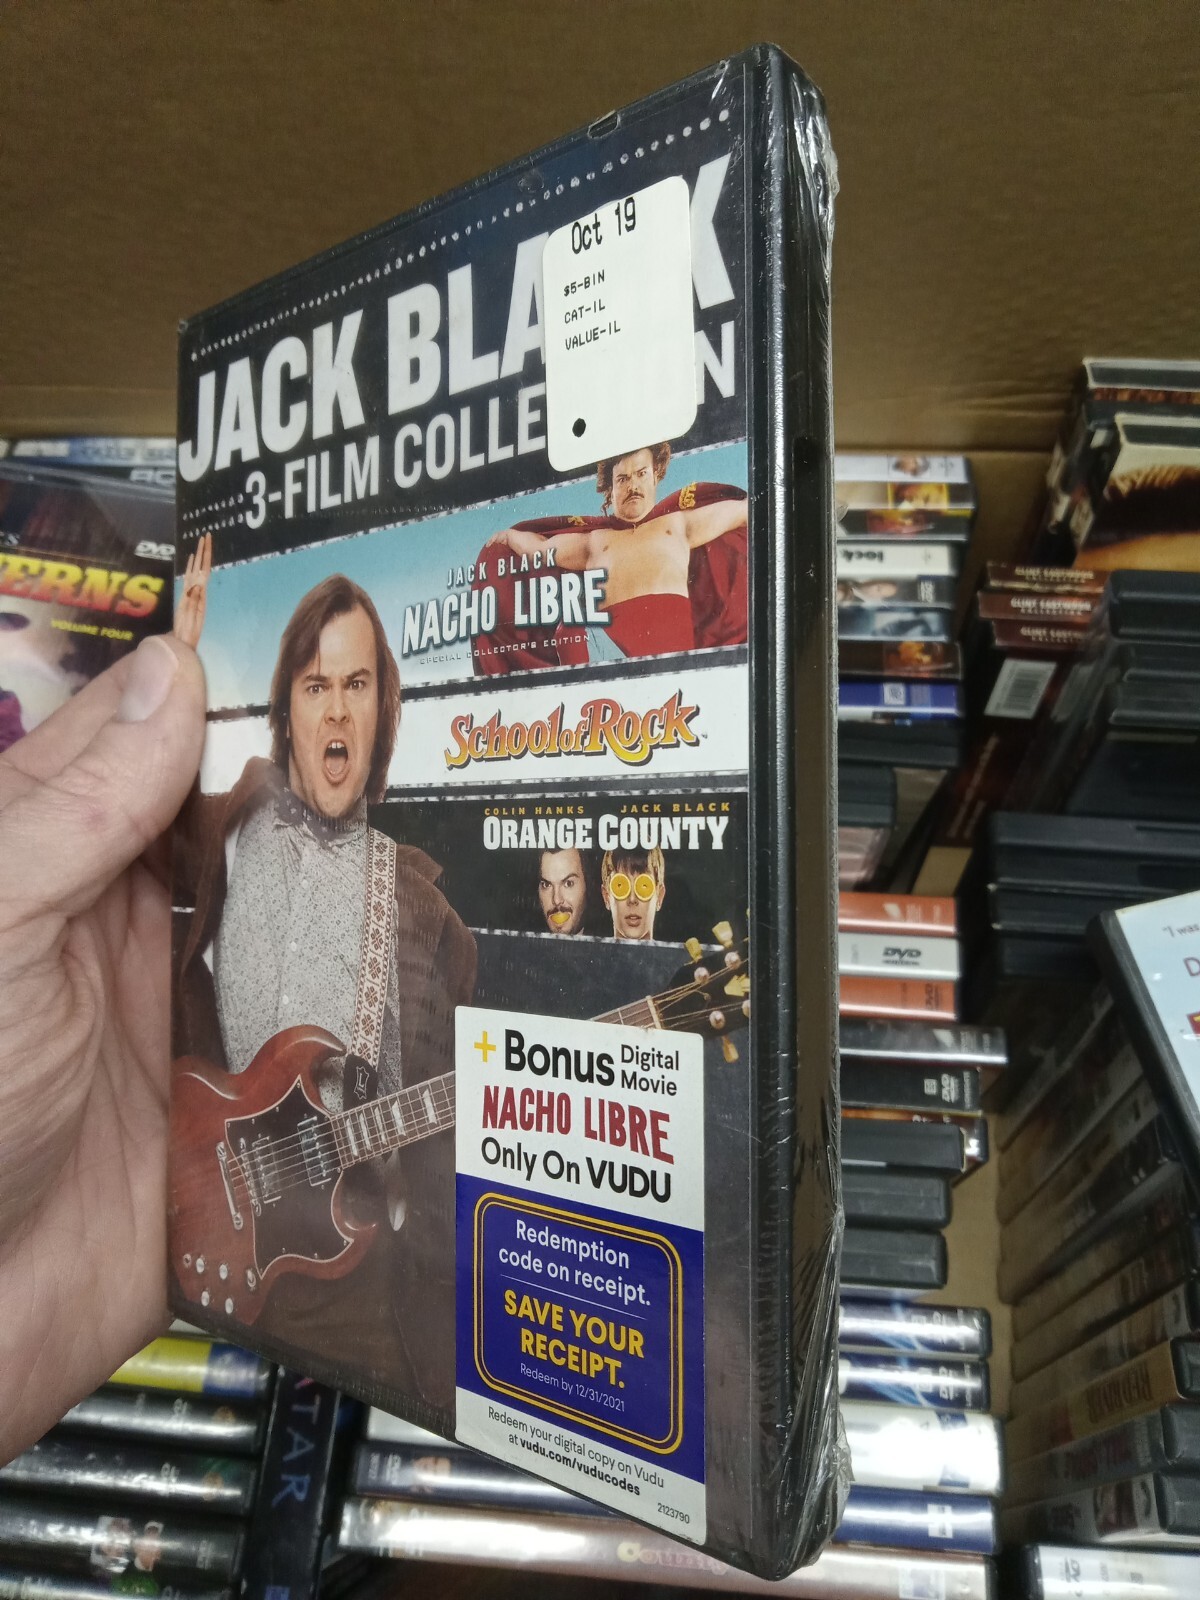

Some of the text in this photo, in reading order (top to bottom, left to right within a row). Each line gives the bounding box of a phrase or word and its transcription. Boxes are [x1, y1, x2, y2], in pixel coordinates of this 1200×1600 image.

[571, 197, 636, 254] Oct 19
[563, 269, 605, 297] $5-BIN
[178, 152, 735, 482] JACK BLAK
[564, 299, 606, 324] CAT-IL
[565, 320, 621, 350] VALUE-IL
[245, 321, 735, 529] 3-FILM COLLEN
[0, 554, 164, 617] ERNS
[447, 548, 556, 588] JACK BLACK
[51, 618, 133, 641] VOLUME FOUR
[402, 568, 610, 656] NACHO LIBRE
[419, 634, 591, 665] SPECIAL COLLECTOR'S EDITION
[444, 687, 701, 771] School of Rock
[483, 813, 729, 851] ORANGE COUNTY
[484, 805, 586, 816] COLIN HANKS
[621, 802, 731, 814] JACK BLACK
[883, 947, 922, 958] DVD
[505, 1028, 615, 1087] Bonus
[621, 1044, 679, 1072] Digital
[621, 1070, 678, 1097] Movie
[482, 1085, 675, 1165] NACHO LIBRE
[481, 1136, 672, 1203] Only On VUDU
[516, 1219, 630, 1269] Redemption
[499, 1247, 651, 1306] code on receipt.
[504, 1289, 645, 1358] SAVE YOUR
[521, 1328, 625, 1389] RECEIPT.
[520, 1363, 626, 1412] Redeem by 12/31/2021
[488, 1406, 665, 1488] Redeem your digital copy on Vudu
[508, 1432, 641, 1496] at vudu.com/vuducodes
[657, 1503, 690, 1524] 2123790
